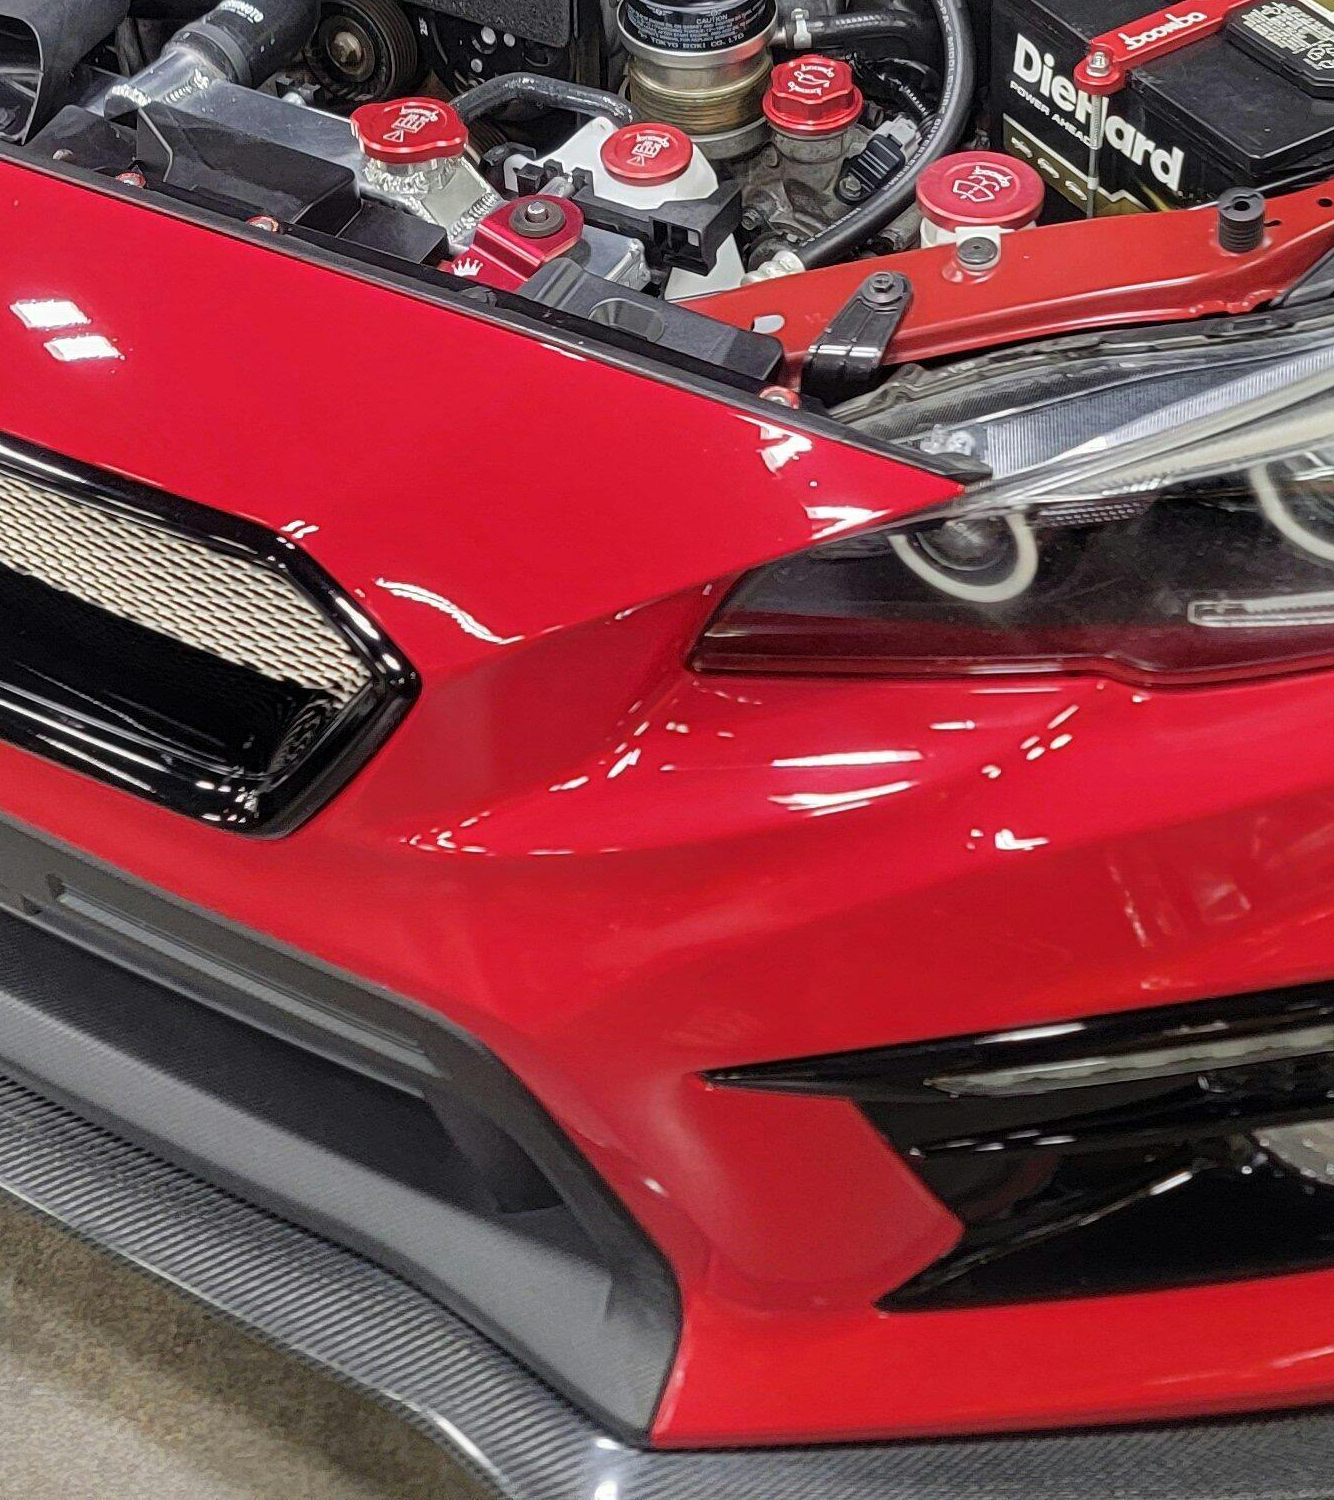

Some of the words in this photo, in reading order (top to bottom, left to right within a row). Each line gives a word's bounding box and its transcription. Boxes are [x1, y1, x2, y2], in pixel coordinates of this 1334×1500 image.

[696, 13, 728, 25] CAUTION
[1118, 11, 1208, 51] boomba
[650, 36, 679, 49] TOKYO
[1009, 80, 1050, 117] POWER
[1012, 32, 1185, 193] DieHard
